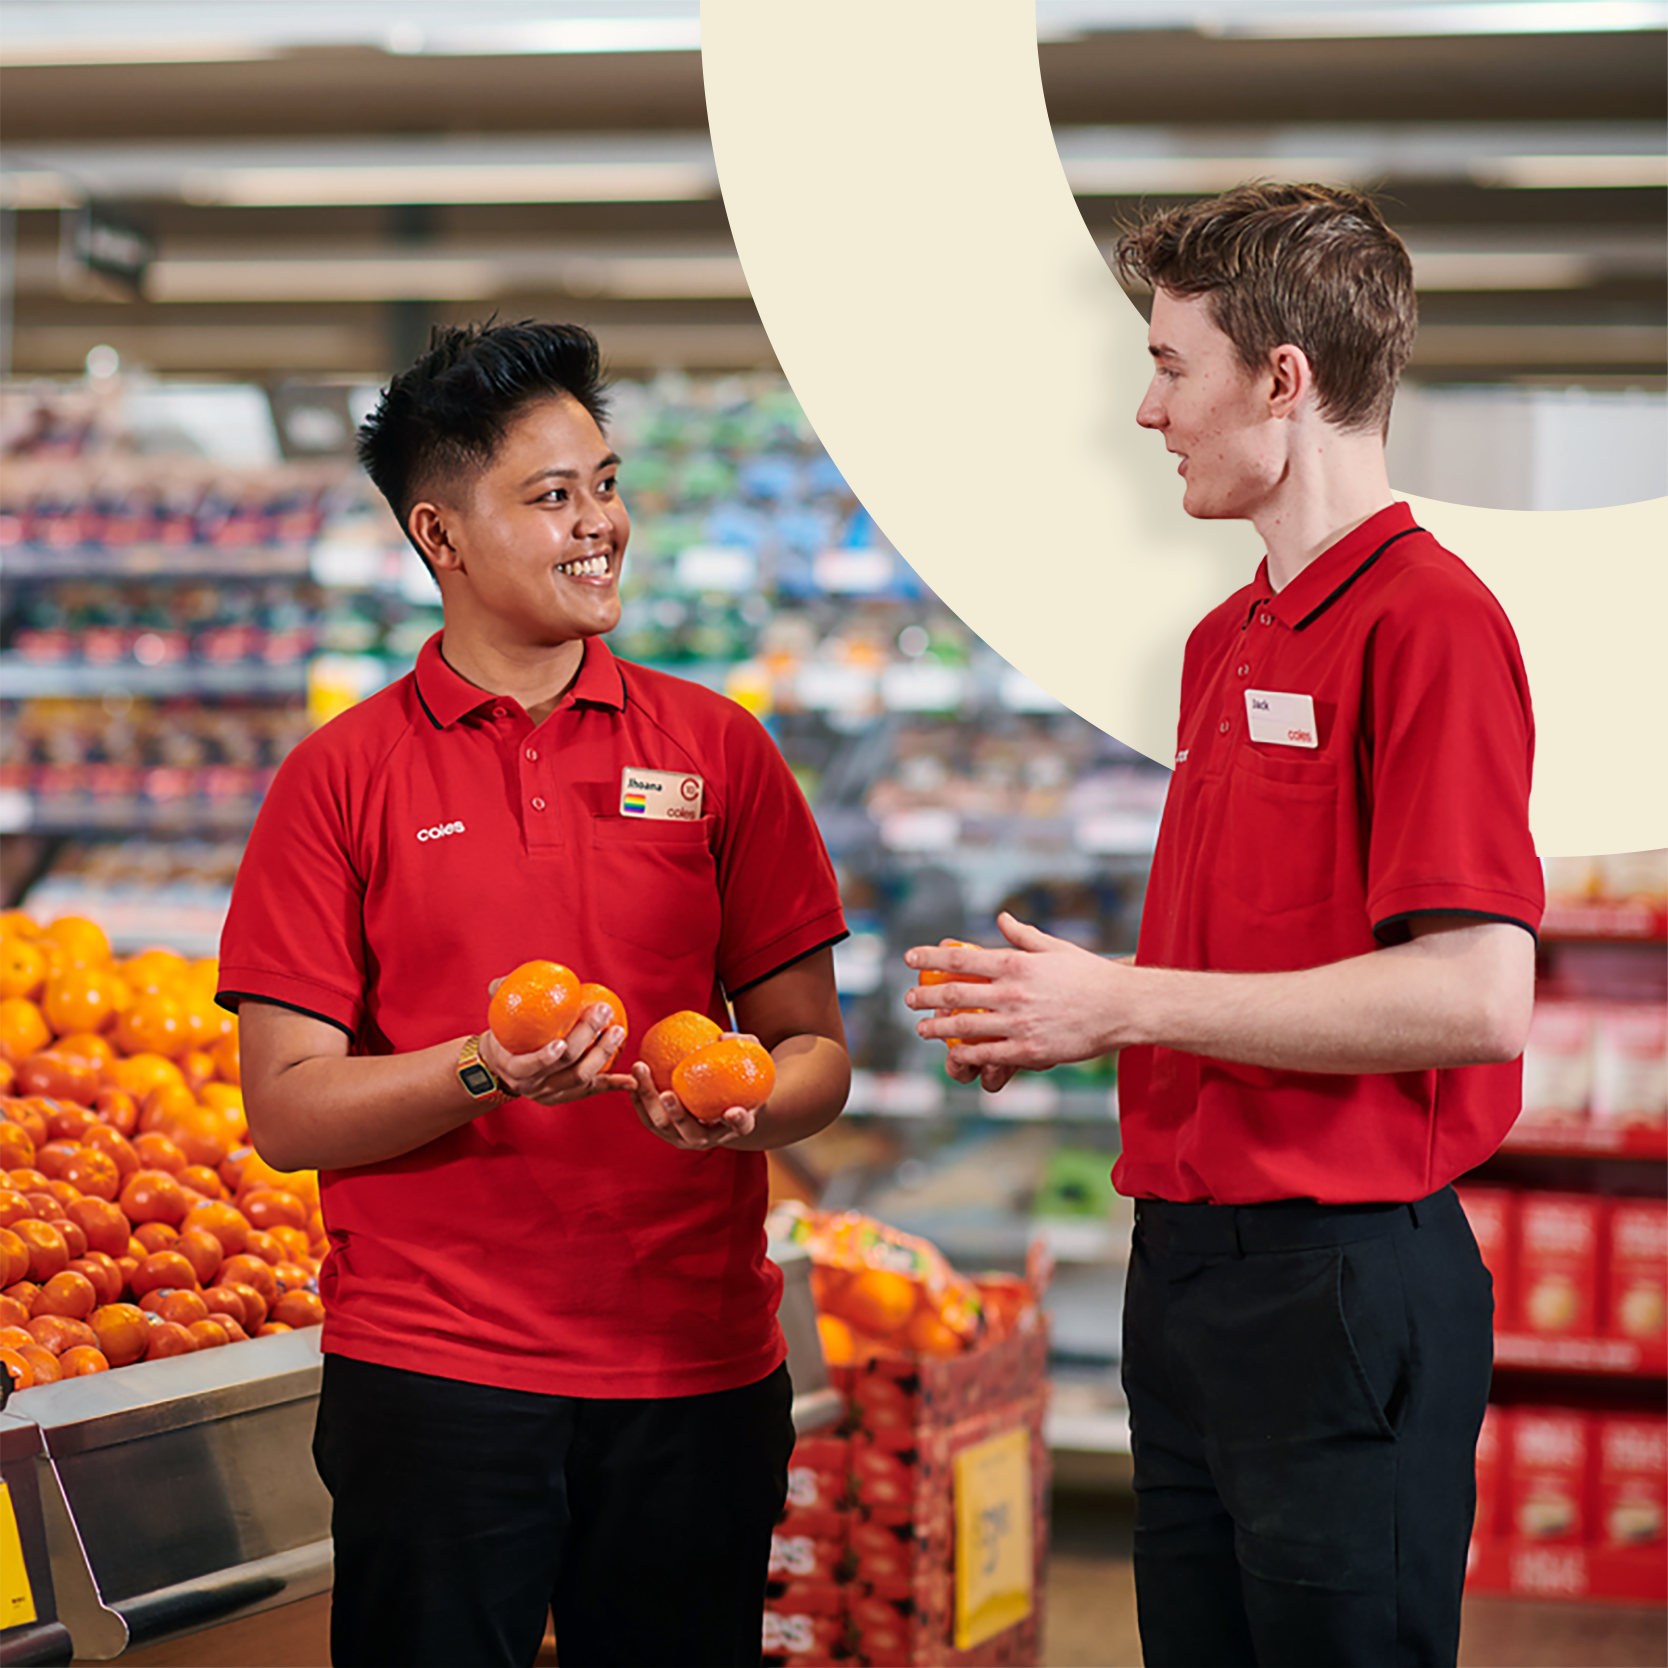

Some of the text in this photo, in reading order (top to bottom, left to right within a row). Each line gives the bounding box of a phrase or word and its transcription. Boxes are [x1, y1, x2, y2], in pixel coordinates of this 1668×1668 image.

[1253, 699, 1269, 711] Jack
[1287, 729, 1312, 742] coles
[628, 778, 662, 792] Jhoana
[666, 806, 696, 820] coles
[417, 821, 465, 841] coles
